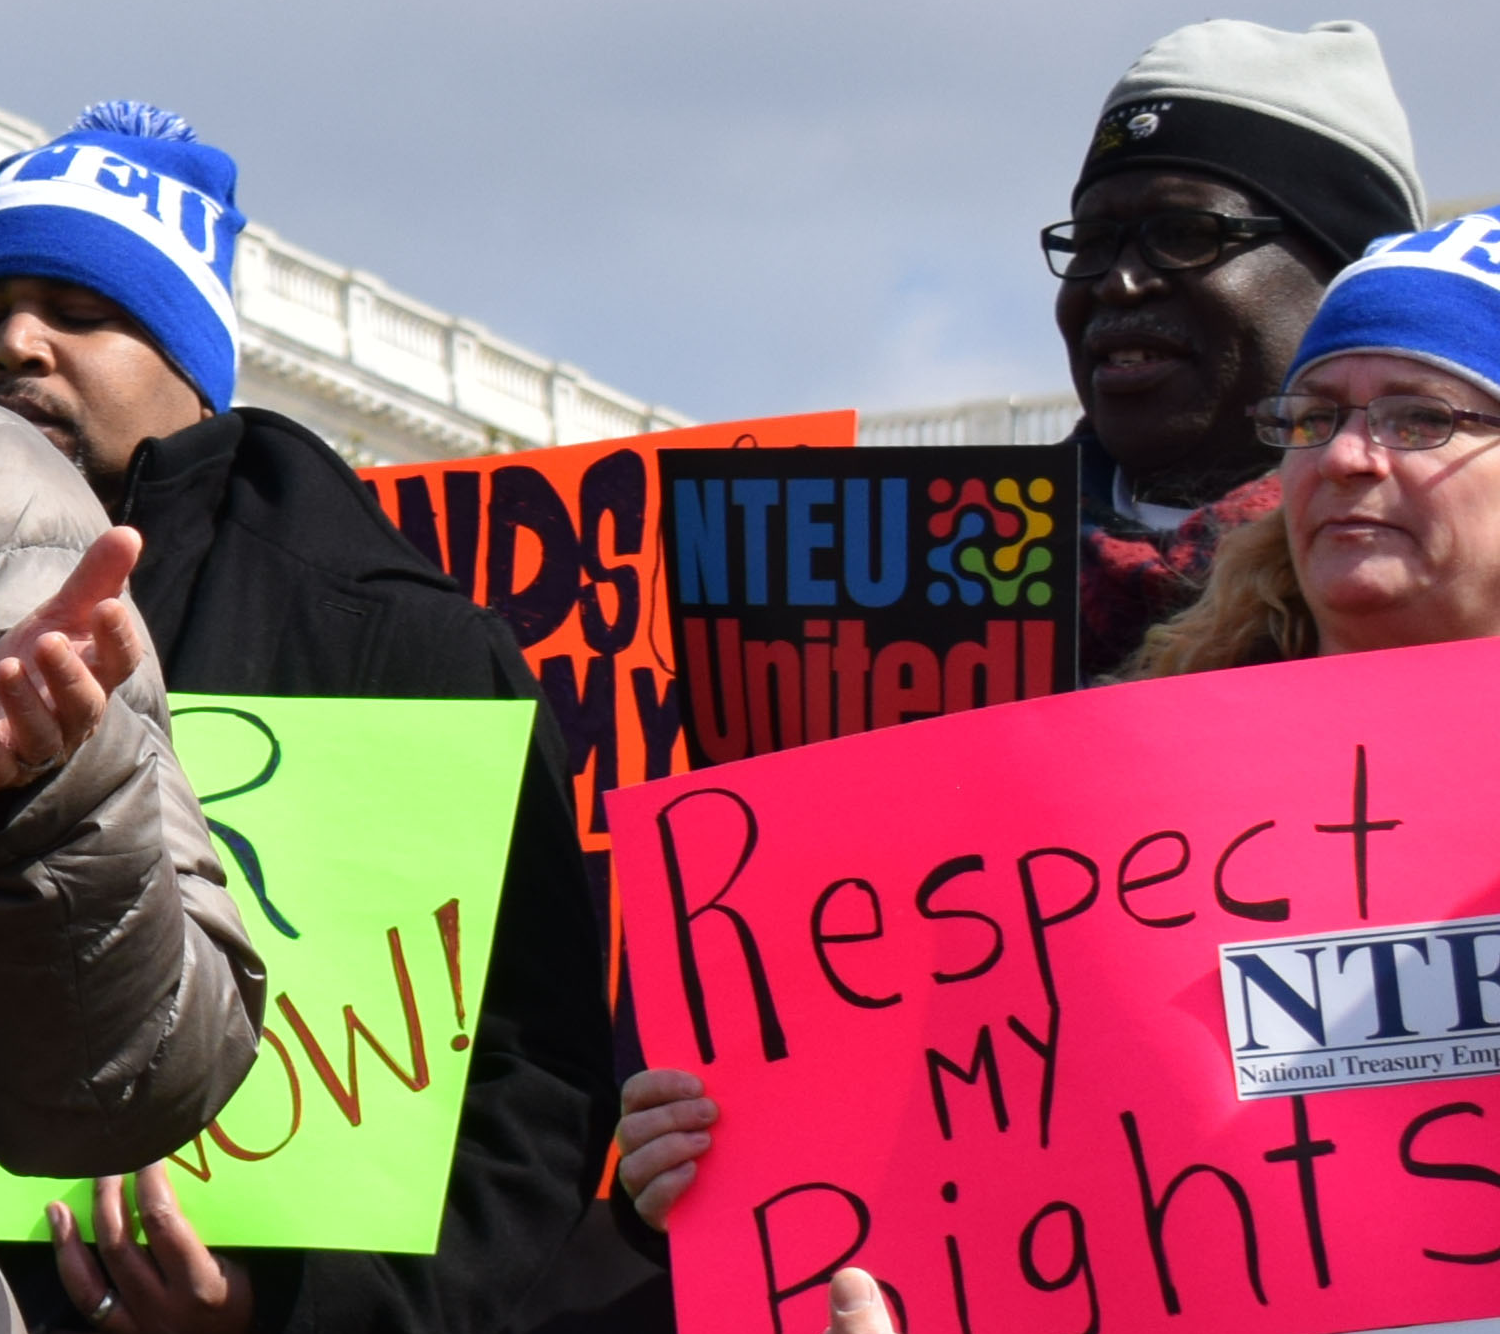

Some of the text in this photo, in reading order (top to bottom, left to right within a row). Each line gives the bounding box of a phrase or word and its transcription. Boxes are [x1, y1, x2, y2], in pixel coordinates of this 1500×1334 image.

[362, 449, 647, 654] NDS
[673, 478, 908, 608] NTEU
[655, 743, 1405, 1065] Respect
[165, 898, 471, 1183] OW!
[924, 1010, 1060, 1148] MY
[1239, 1058, 1336, 1085] National
[1341, 1051, 1444, 1074] Treasury
